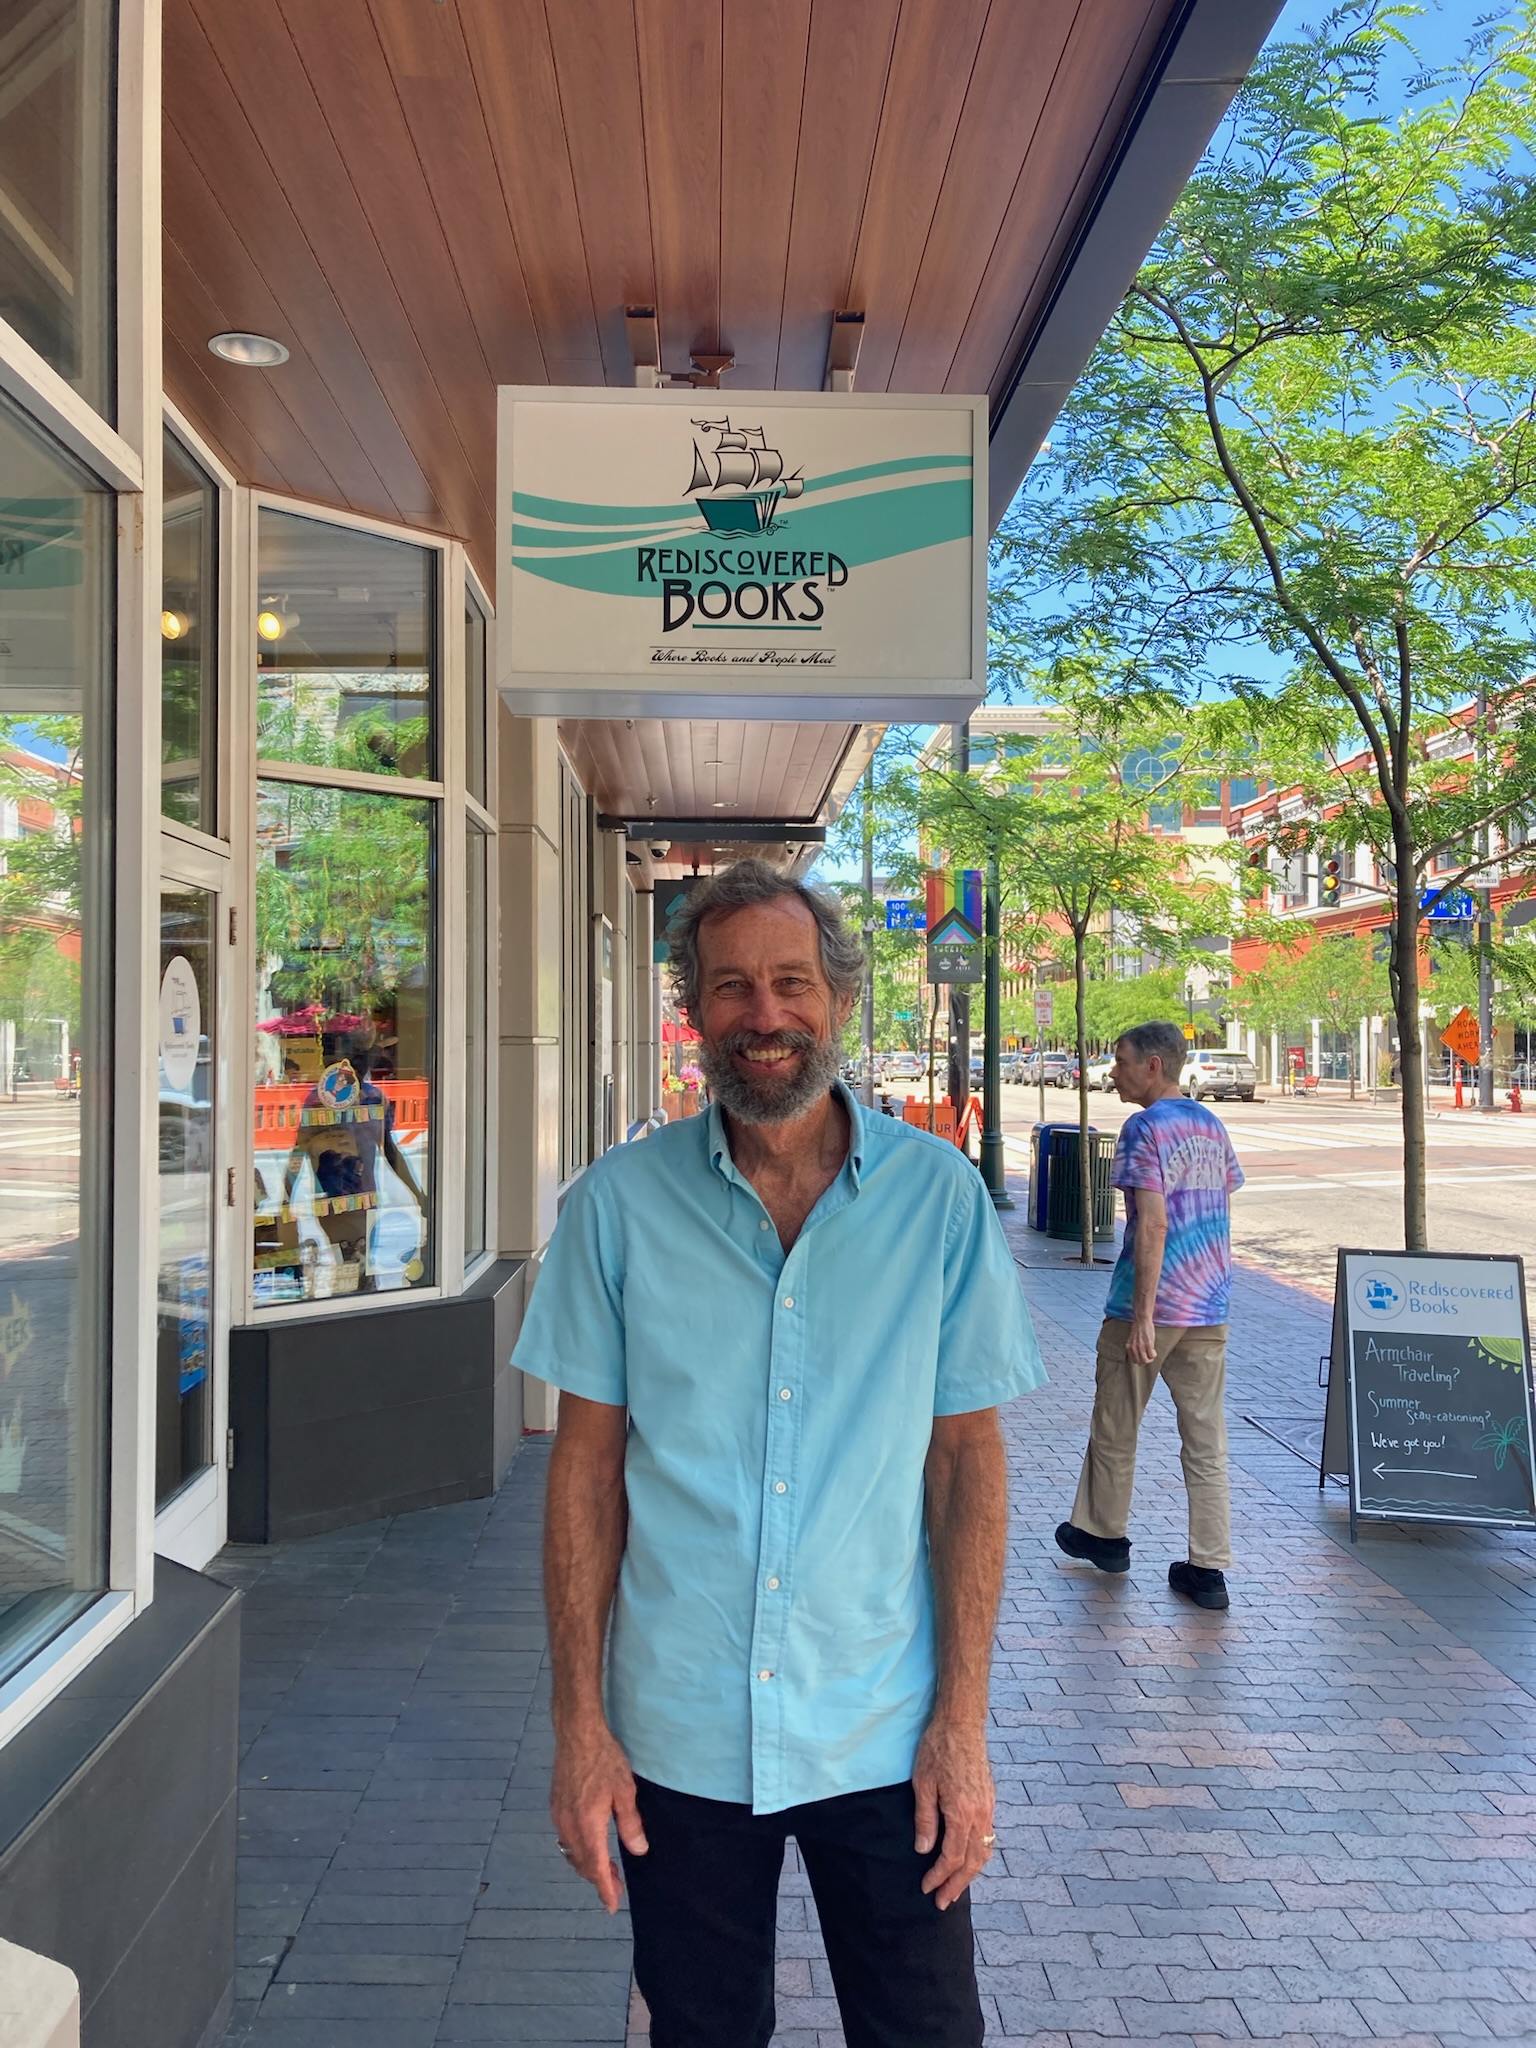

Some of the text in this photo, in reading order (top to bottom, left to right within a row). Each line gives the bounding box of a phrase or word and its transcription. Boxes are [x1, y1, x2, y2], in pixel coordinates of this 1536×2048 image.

[637, 547, 849, 587] REDISCOVERED
[662, 578, 824, 633] BOOKS
[651, 648, 836, 667] Where Books and People Meet
[891, 902, 906, 911] 100
[1457, 1041, 1479, 1051] AHEA
[1409, 1298, 1459, 1315] Books
[1364, 1337, 1435, 1363] Armchair
[1393, 1363, 1461, 1390] Traveling?
[1367, 1390, 1421, 1418] Summer
[1405, 1410, 1491, 1431] Stay-cationing?
[1370, 1431, 1446, 1456] We've got you!
